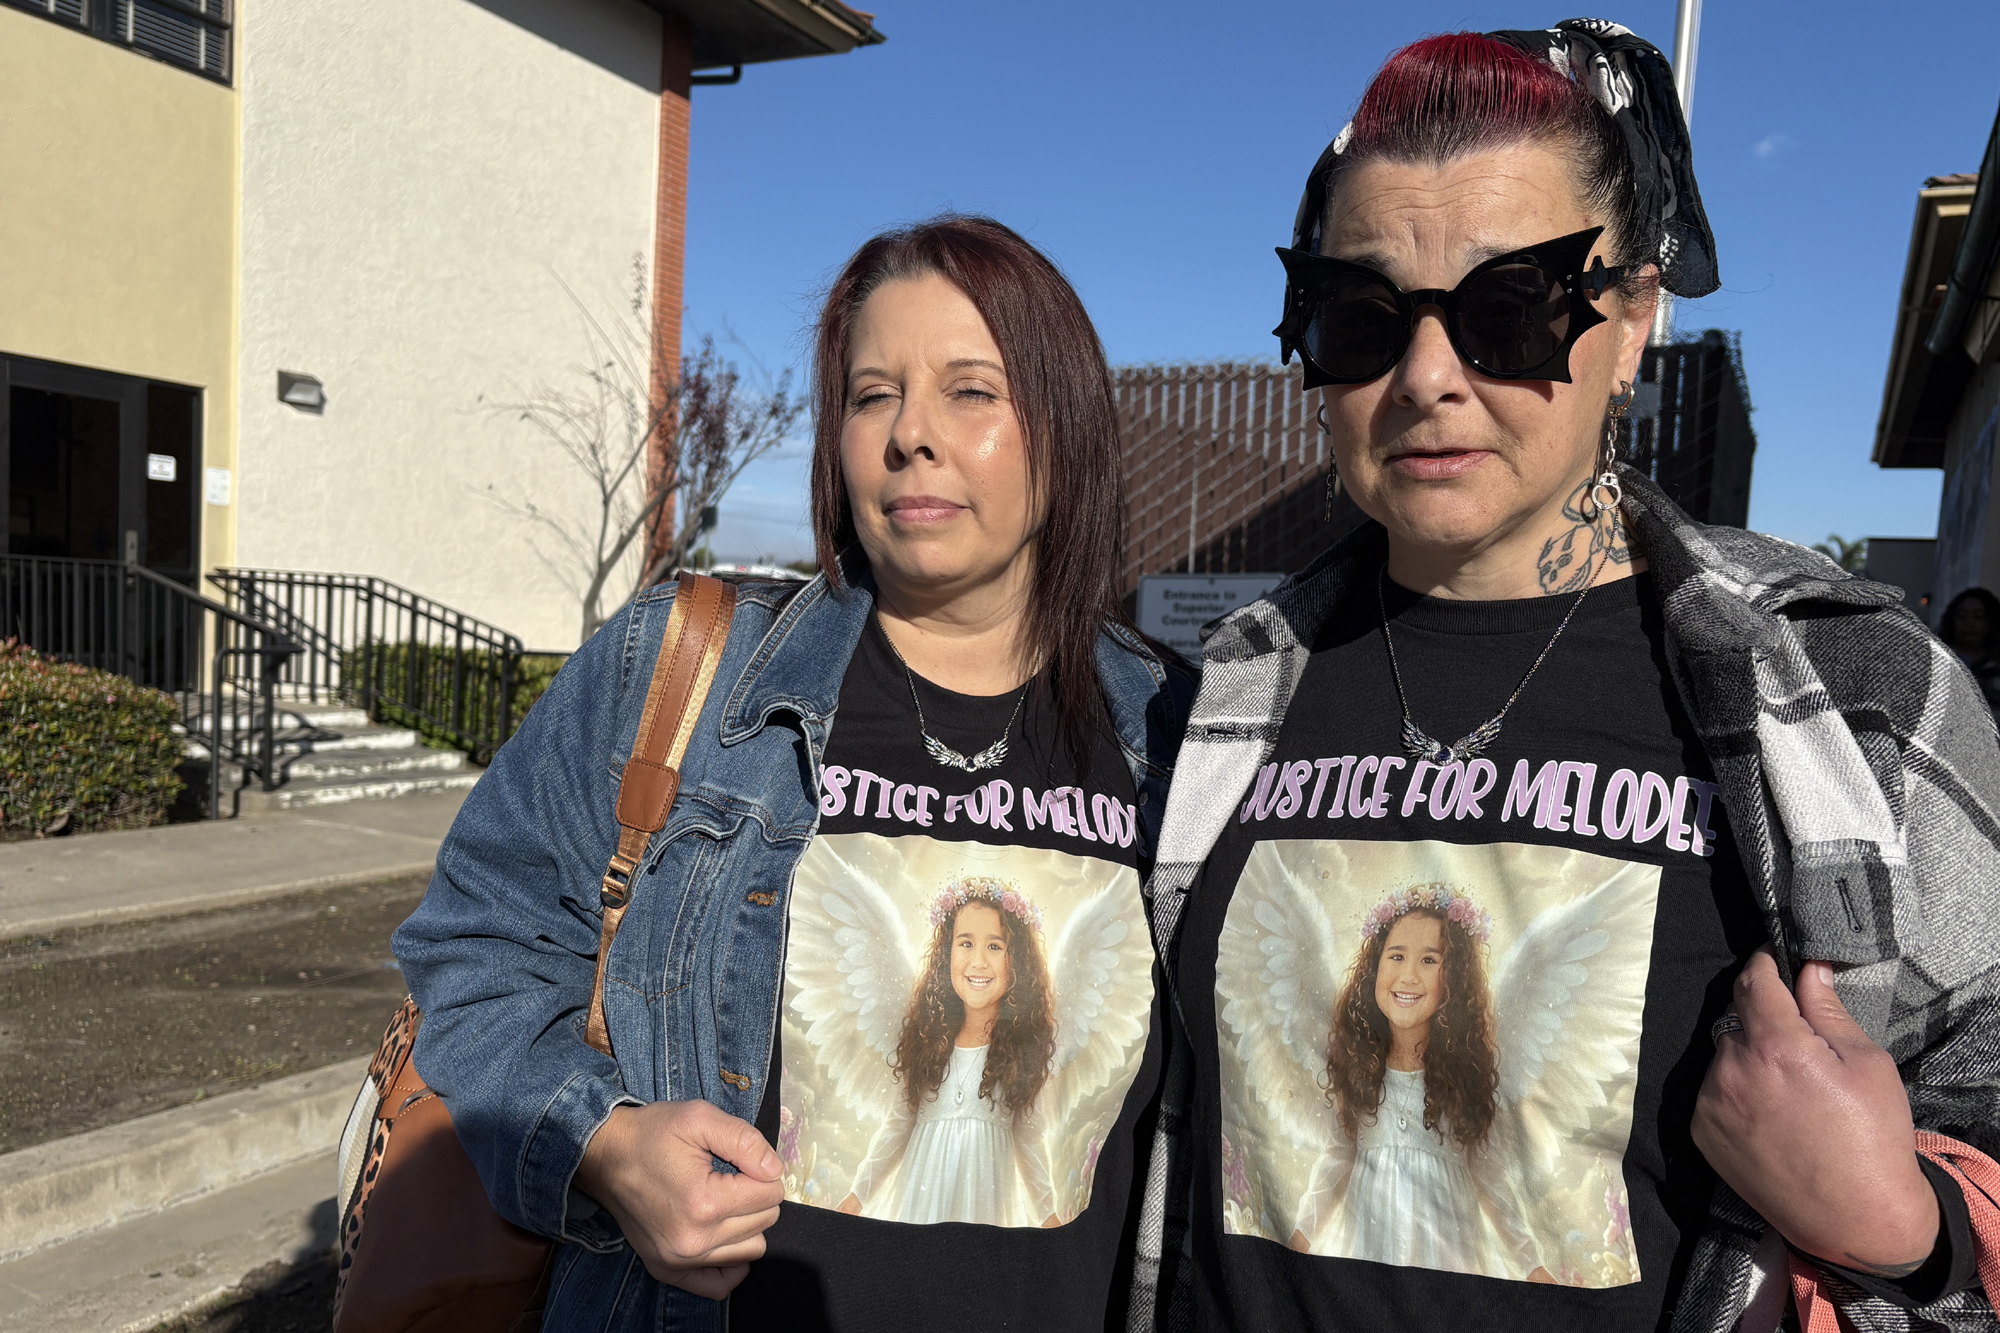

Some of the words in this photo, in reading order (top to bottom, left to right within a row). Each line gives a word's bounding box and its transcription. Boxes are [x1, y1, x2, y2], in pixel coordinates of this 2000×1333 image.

[1163, 590, 1220, 600] Entrance
[1223, 590, 1237, 600] to
[1173, 602, 1226, 614] Superior
[944, 779, 1015, 832] FOR
[1239, 755, 1407, 824] JUSTICE
[1401, 758, 1498, 821] FOR
[1500, 758, 1721, 857] MELODEE
